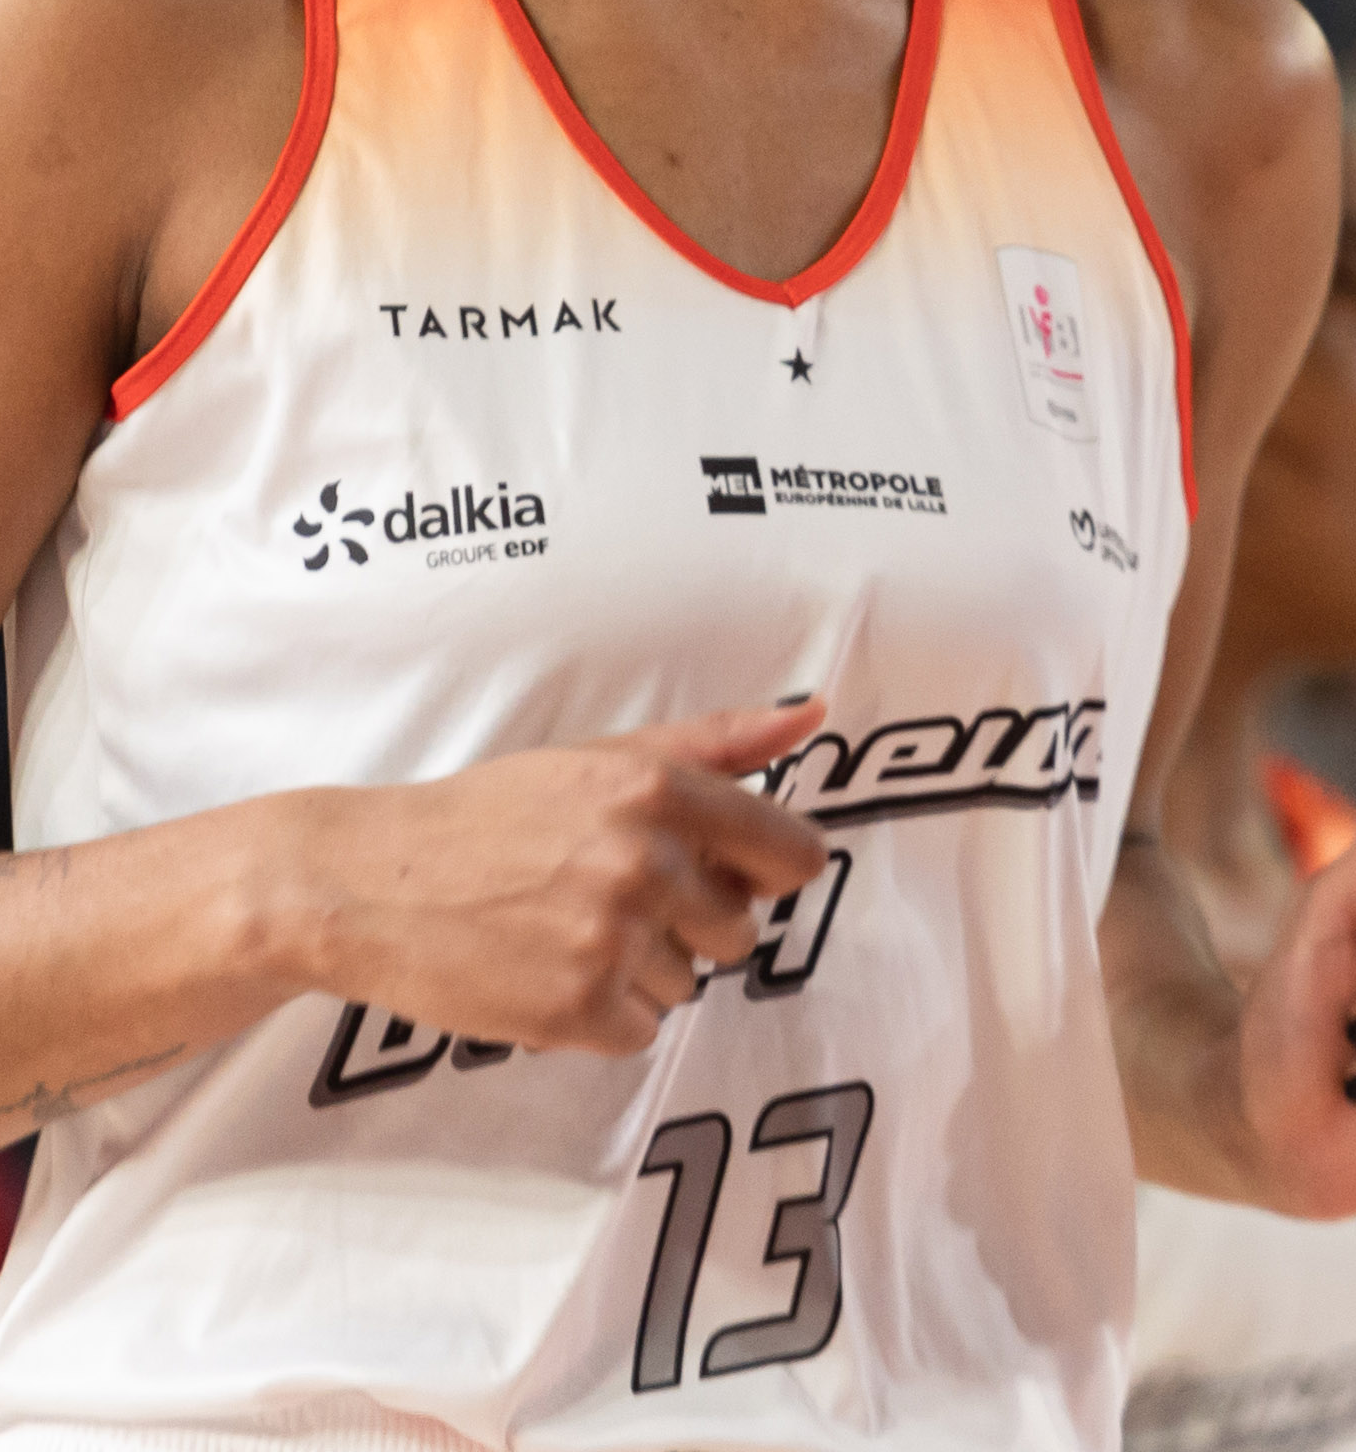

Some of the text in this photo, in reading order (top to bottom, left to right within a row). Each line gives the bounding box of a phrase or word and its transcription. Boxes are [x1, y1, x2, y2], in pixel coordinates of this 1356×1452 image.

[379, 298, 622, 339] TARMAK
[770, 464, 943, 497] MÉTROPOLE
[383, 481, 546, 544] dalkia
[426, 543, 497, 569] GROUPE
[632, 1080, 875, 1395] 13
